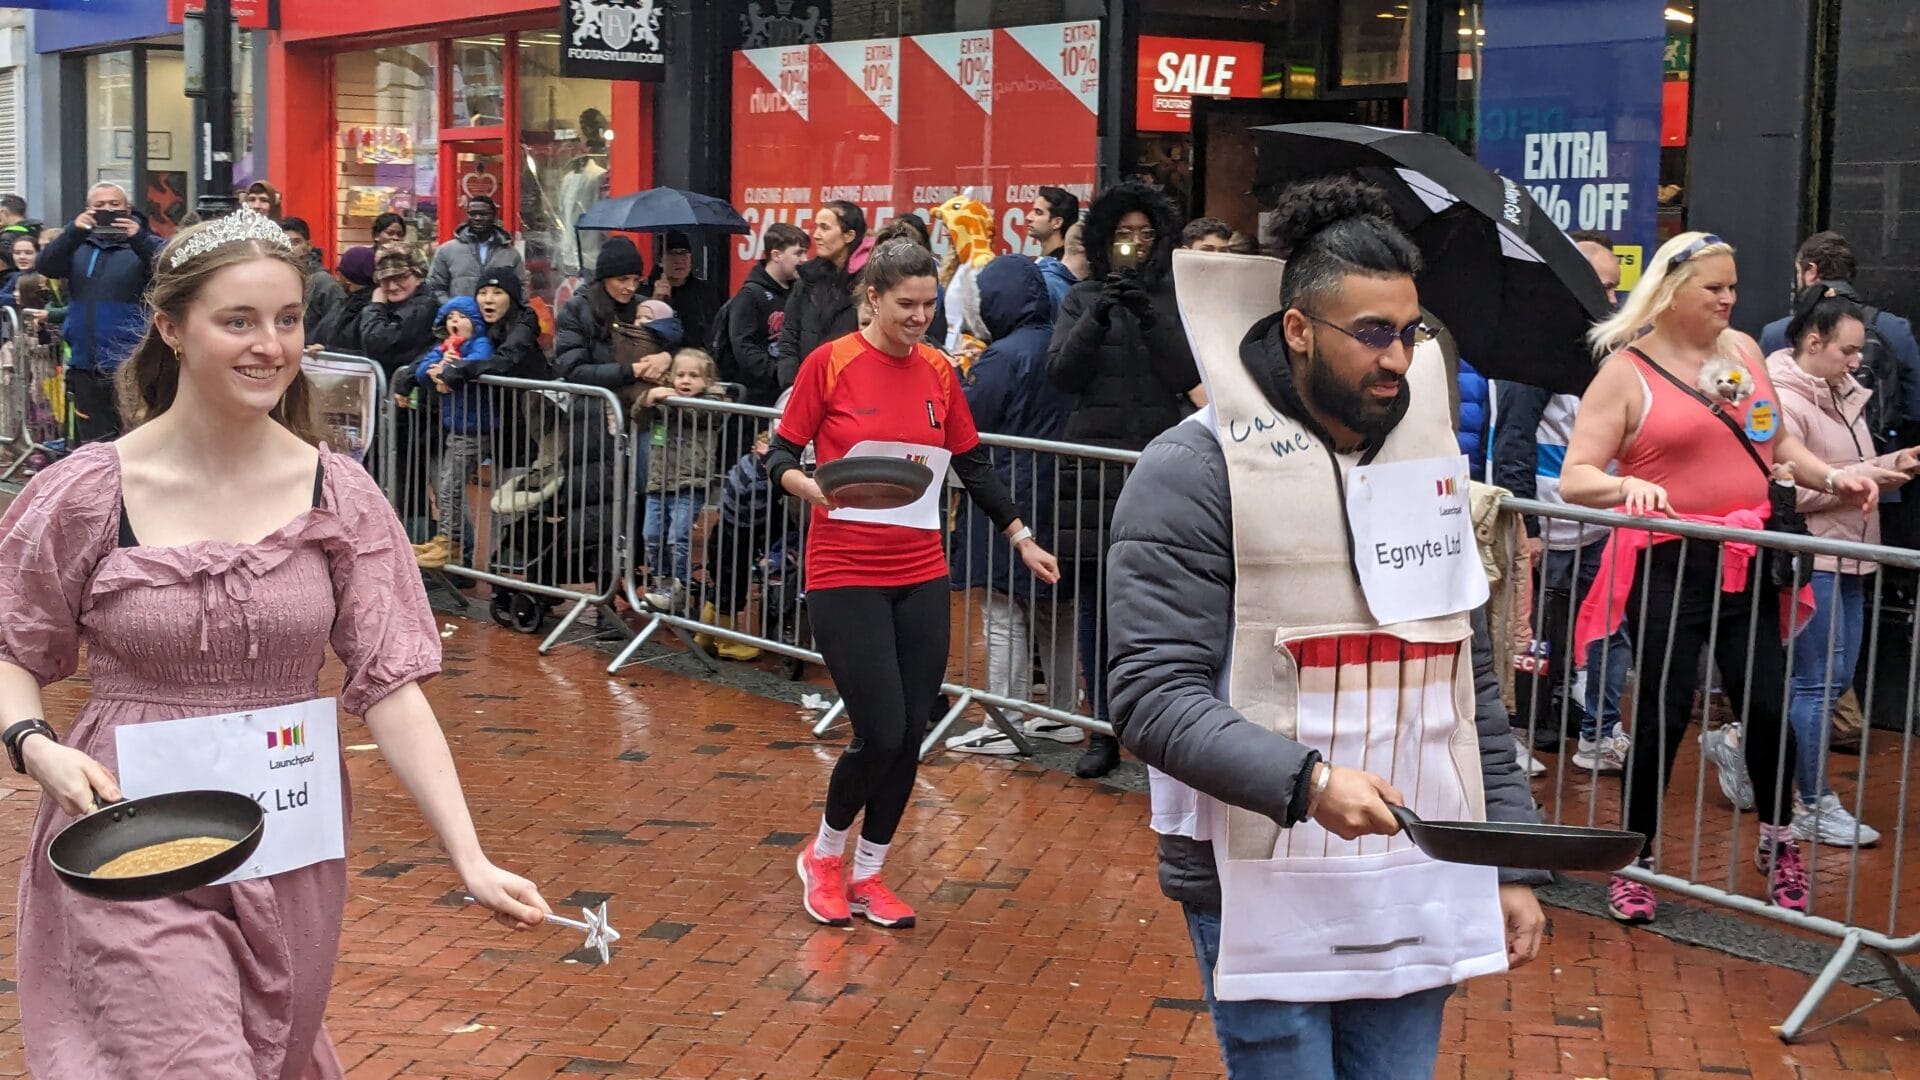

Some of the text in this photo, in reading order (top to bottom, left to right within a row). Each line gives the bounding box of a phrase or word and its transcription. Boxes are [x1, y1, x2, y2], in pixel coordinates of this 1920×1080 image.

[1063, 24, 1096, 44] EXTRA
[865, 45, 893, 62] EXTRA
[961, 37, 990, 54] EXTRA
[568, 48, 665, 64] FOOTASYLUM.COM
[781, 51, 808, 67] EXTRA
[1060, 43, 1097, 77] 10%
[862, 62, 893, 92] 10%
[957, 56, 991, 86] 10%
[1153, 51, 1237, 95] SALE
[1080, 78, 1097, 93] OFF
[878, 94, 893, 108] OFF
[976, 89, 991, 102] OFF
[1155, 98, 1192, 110] FOOTAS
[1524, 130, 1608, 180] EXTRA
[745, 187, 811, 204] CLOSING DOWN
[820, 184, 894, 203] CLOSING DOWN
[1578, 182, 1630, 231] OFF
[1614, 254, 1635, 266] TS
[1375, 532, 1461, 569] Egnyte Ltd
[269, 751, 315, 770] Launchpad
[275, 781, 308, 811] Ltd
